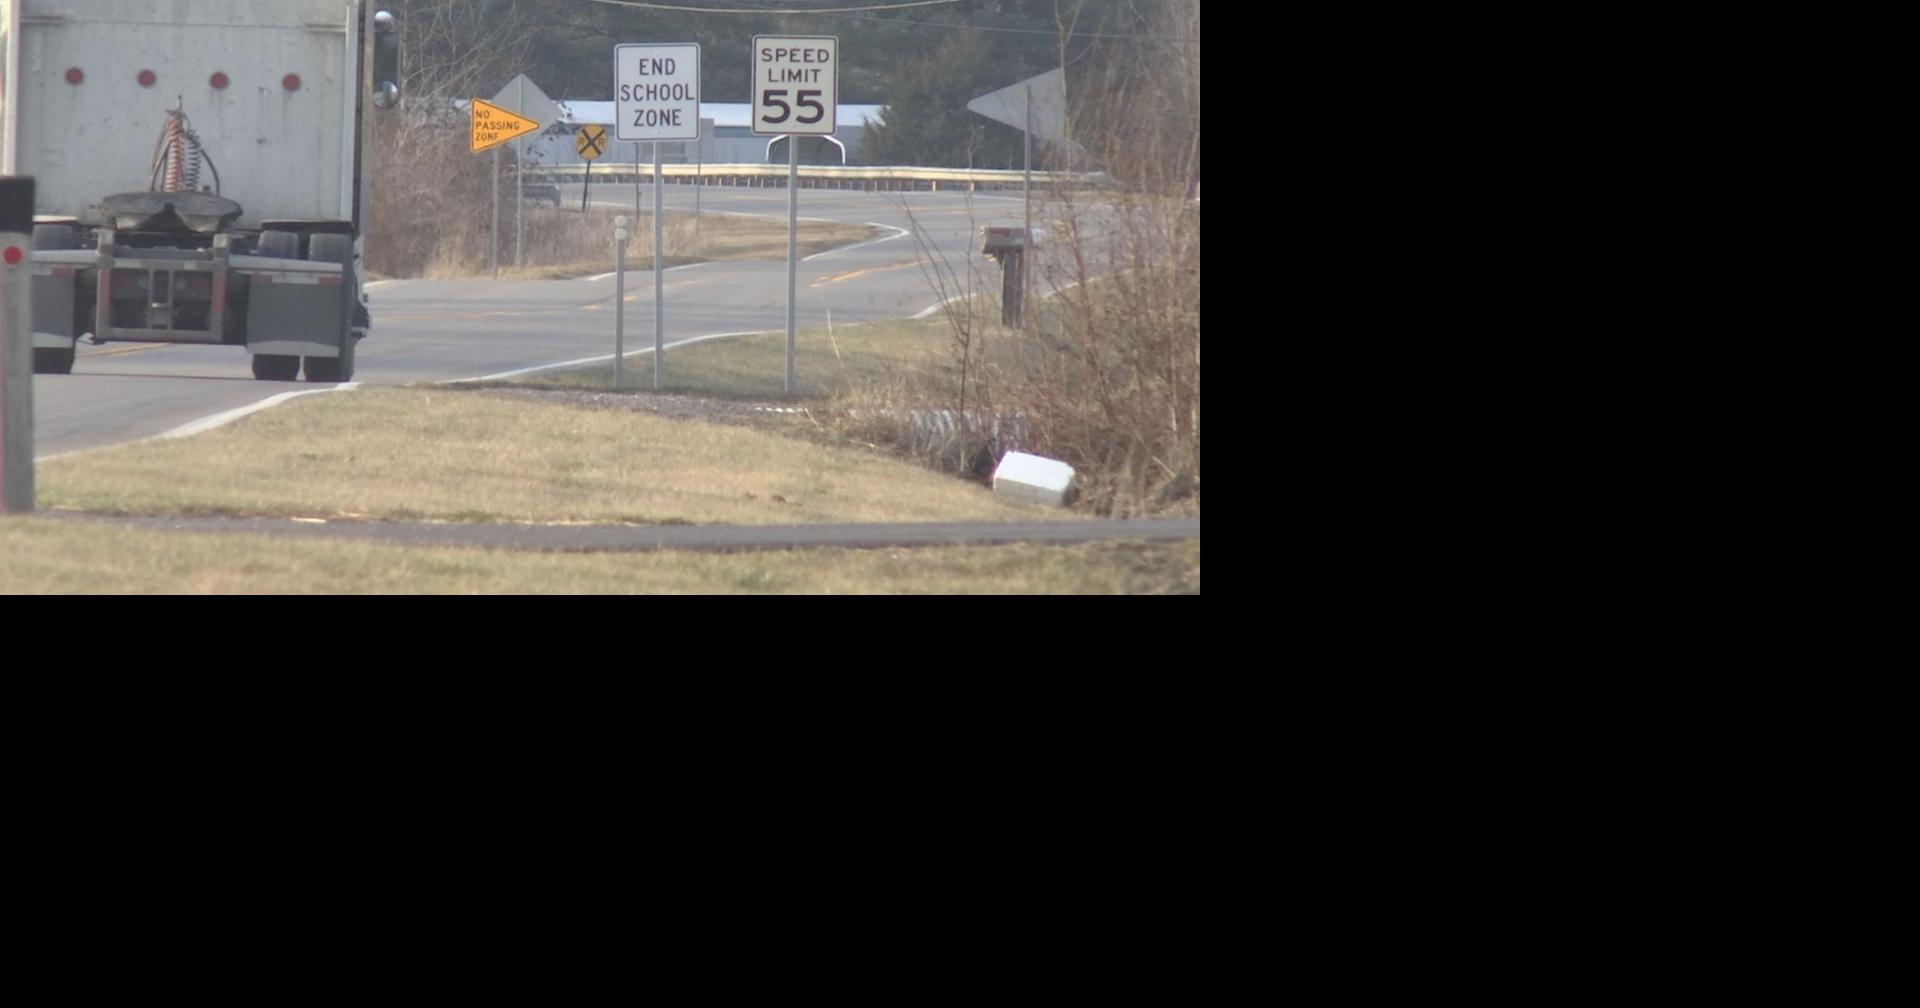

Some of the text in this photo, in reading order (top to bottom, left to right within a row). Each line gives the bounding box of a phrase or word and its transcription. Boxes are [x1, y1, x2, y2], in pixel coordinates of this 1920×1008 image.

[761, 48, 829, 63] SPEED
[639, 58, 676, 76] END
[768, 68, 821, 83] LIMIT
[620, 83, 695, 102] SCHOOL
[475, 110, 490, 119] NO
[761, 89, 824, 124] 55
[475, 121, 520, 130] PASSING
[633, 109, 682, 127] ZONE
